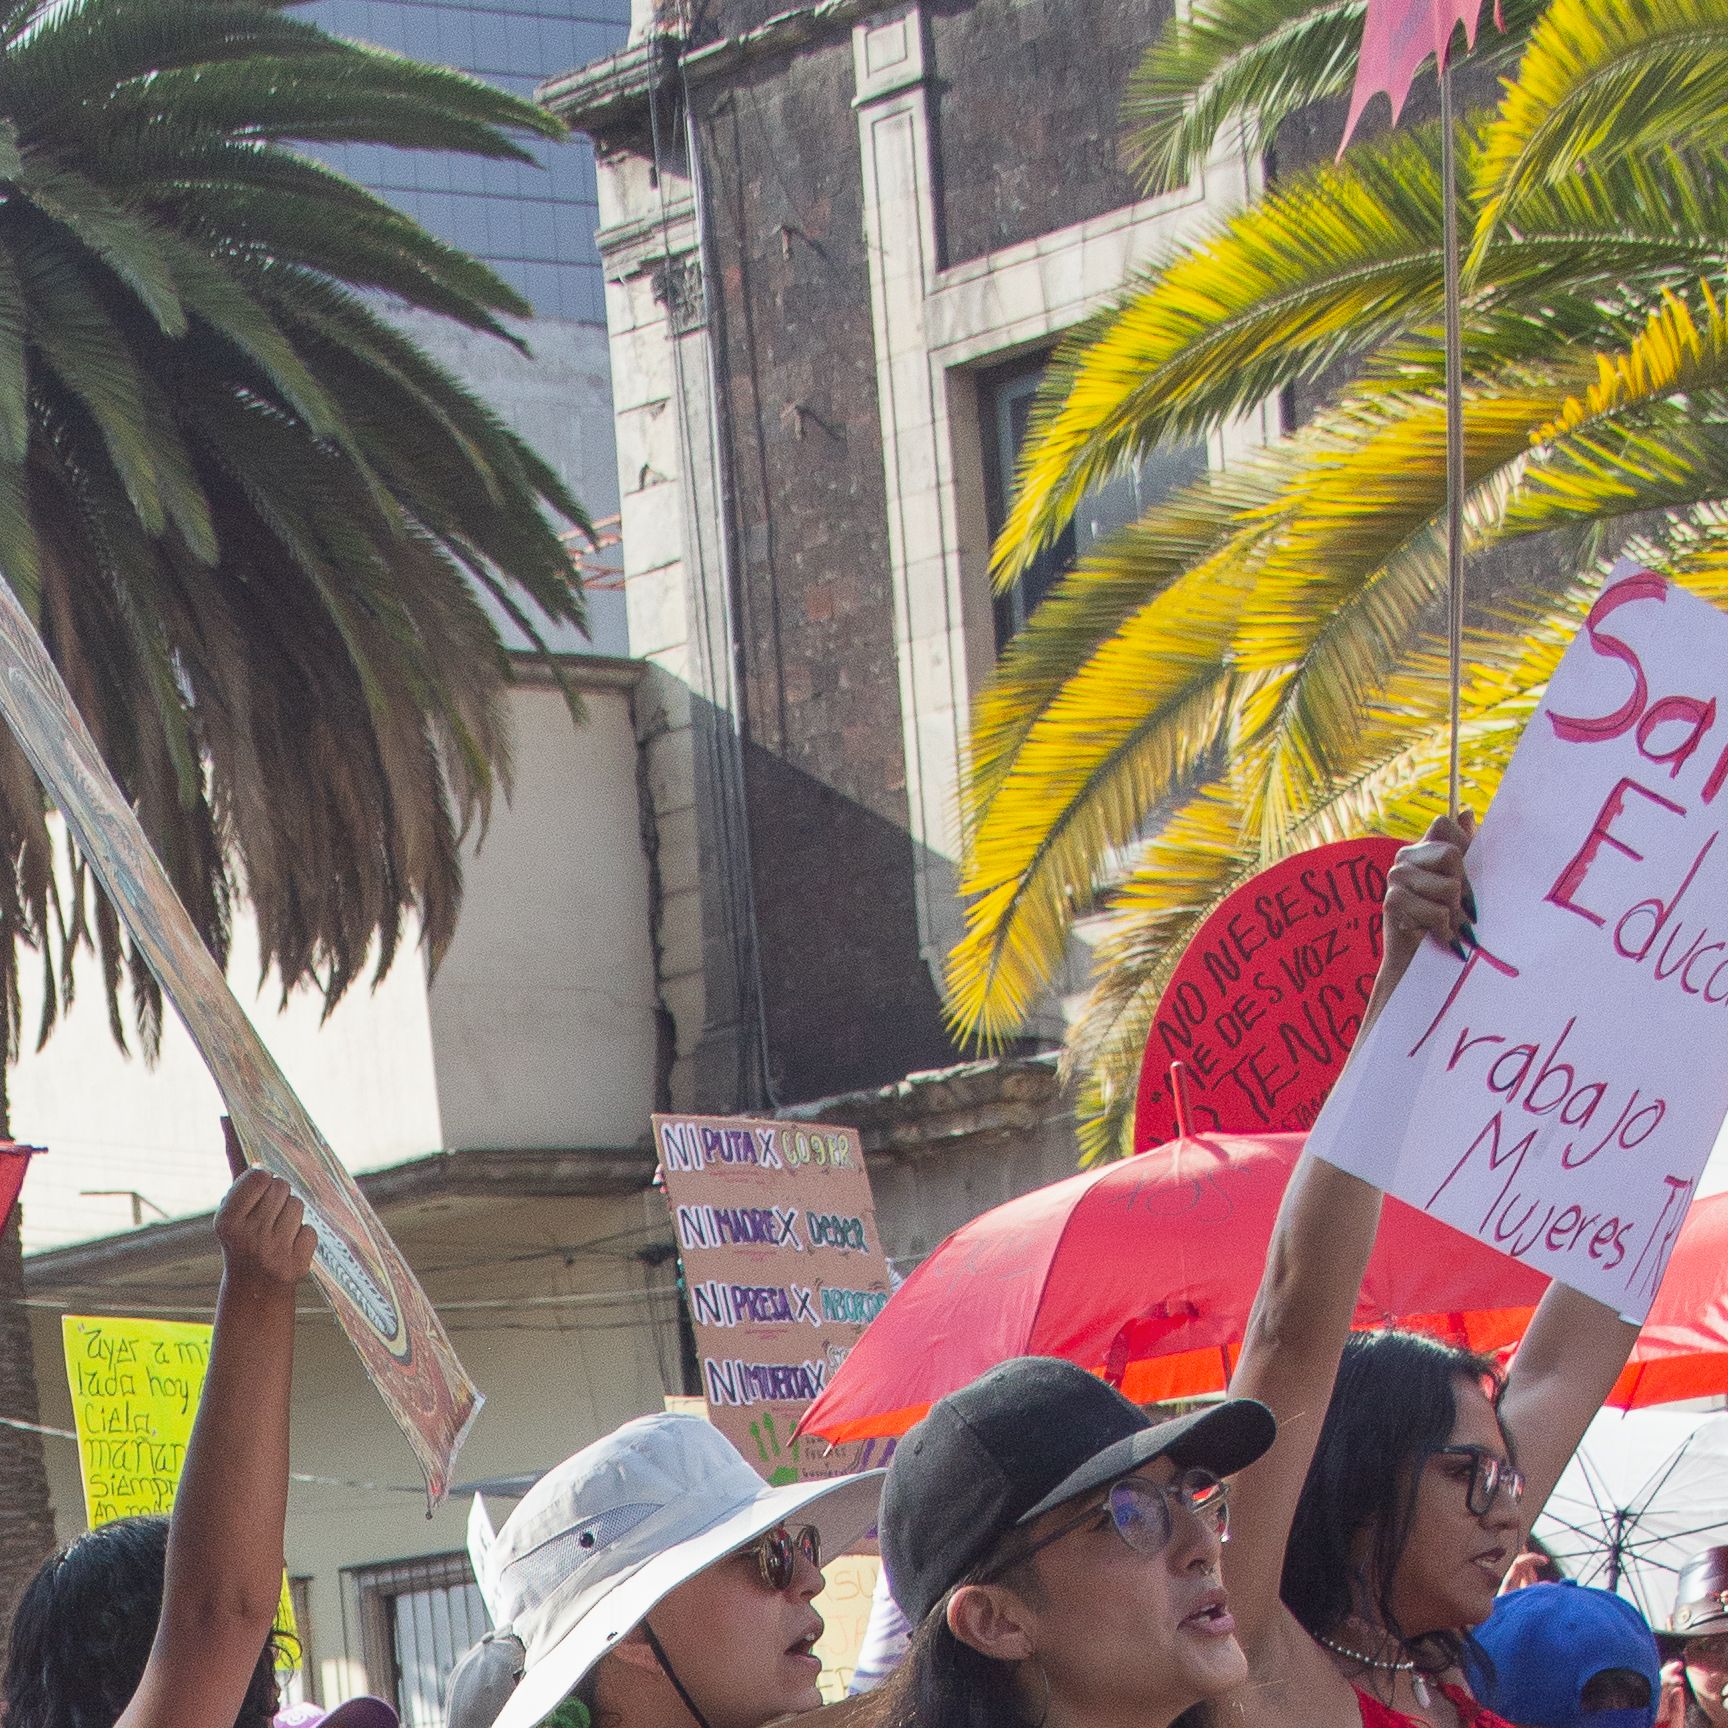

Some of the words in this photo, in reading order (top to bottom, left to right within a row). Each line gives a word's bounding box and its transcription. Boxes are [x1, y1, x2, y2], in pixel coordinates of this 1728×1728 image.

[1157, 980, 1208, 1058] NO
[1215, 971, 1283, 1049] DES
[1408, 945, 1668, 1170] Trabajo
[661, 1123, 704, 1171] NI
[702, 1128, 758, 1164] PUTA
[1425, 1110, 1634, 1270] Mujeres
[677, 1206, 721, 1249] NI
[692, 1281, 736, 1327] NI
[146, 1366, 189, 1414] hoy
[704, 1358, 753, 1406] NI
[90, 1473, 178, 1509] Siempr
